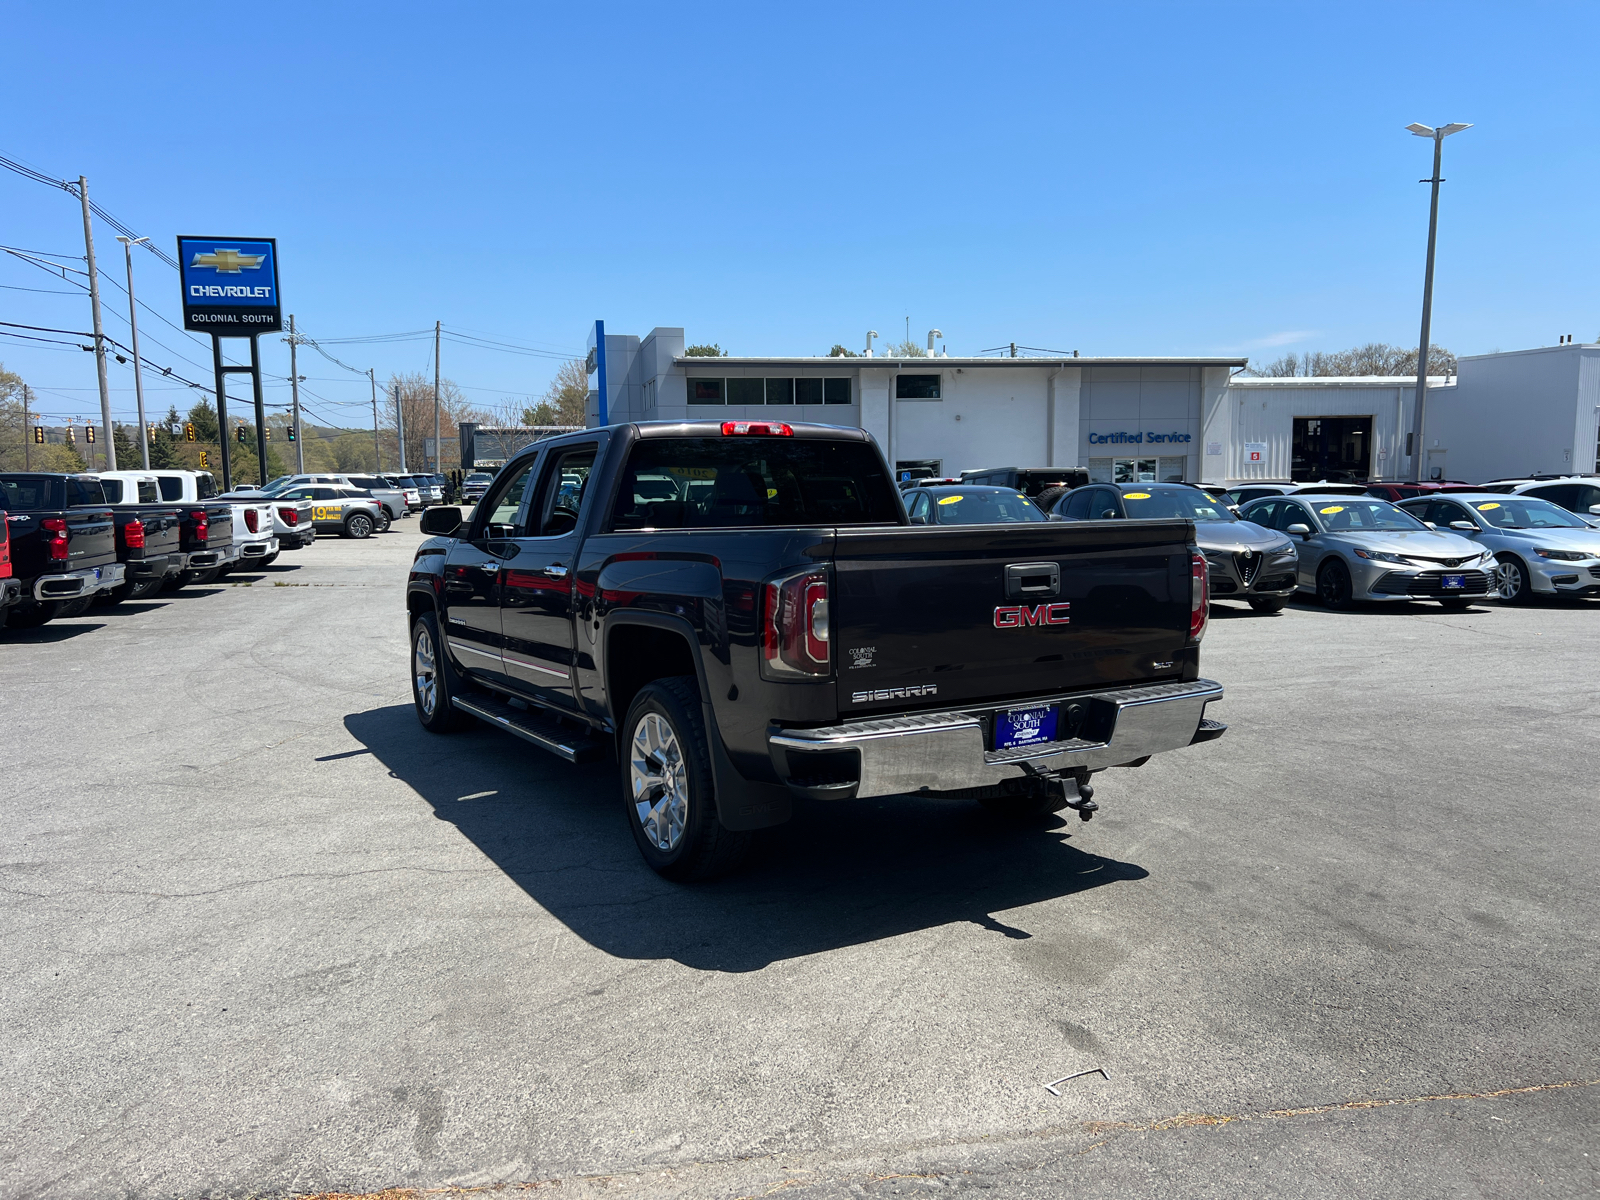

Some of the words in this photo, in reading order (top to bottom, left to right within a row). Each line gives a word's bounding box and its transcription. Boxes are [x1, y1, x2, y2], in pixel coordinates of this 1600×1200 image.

[190, 285, 271, 298] CHEVROLET
[191, 313, 240, 323] COLONIAL
[242, 314, 274, 323] SOUTH
[1089, 432, 1143, 445] Certified
[1146, 432, 1192, 444] Service
[993, 602, 1070, 628] GMC
[849, 646, 877, 654] COLONIAL
[853, 652, 873, 660] SOUTH
[852, 684, 937, 703] SIERRA
[1008, 711, 1046, 723] COLONIAL
[1013, 719, 1040, 730] SOUTH
[738, 800, 780, 816] GMC
